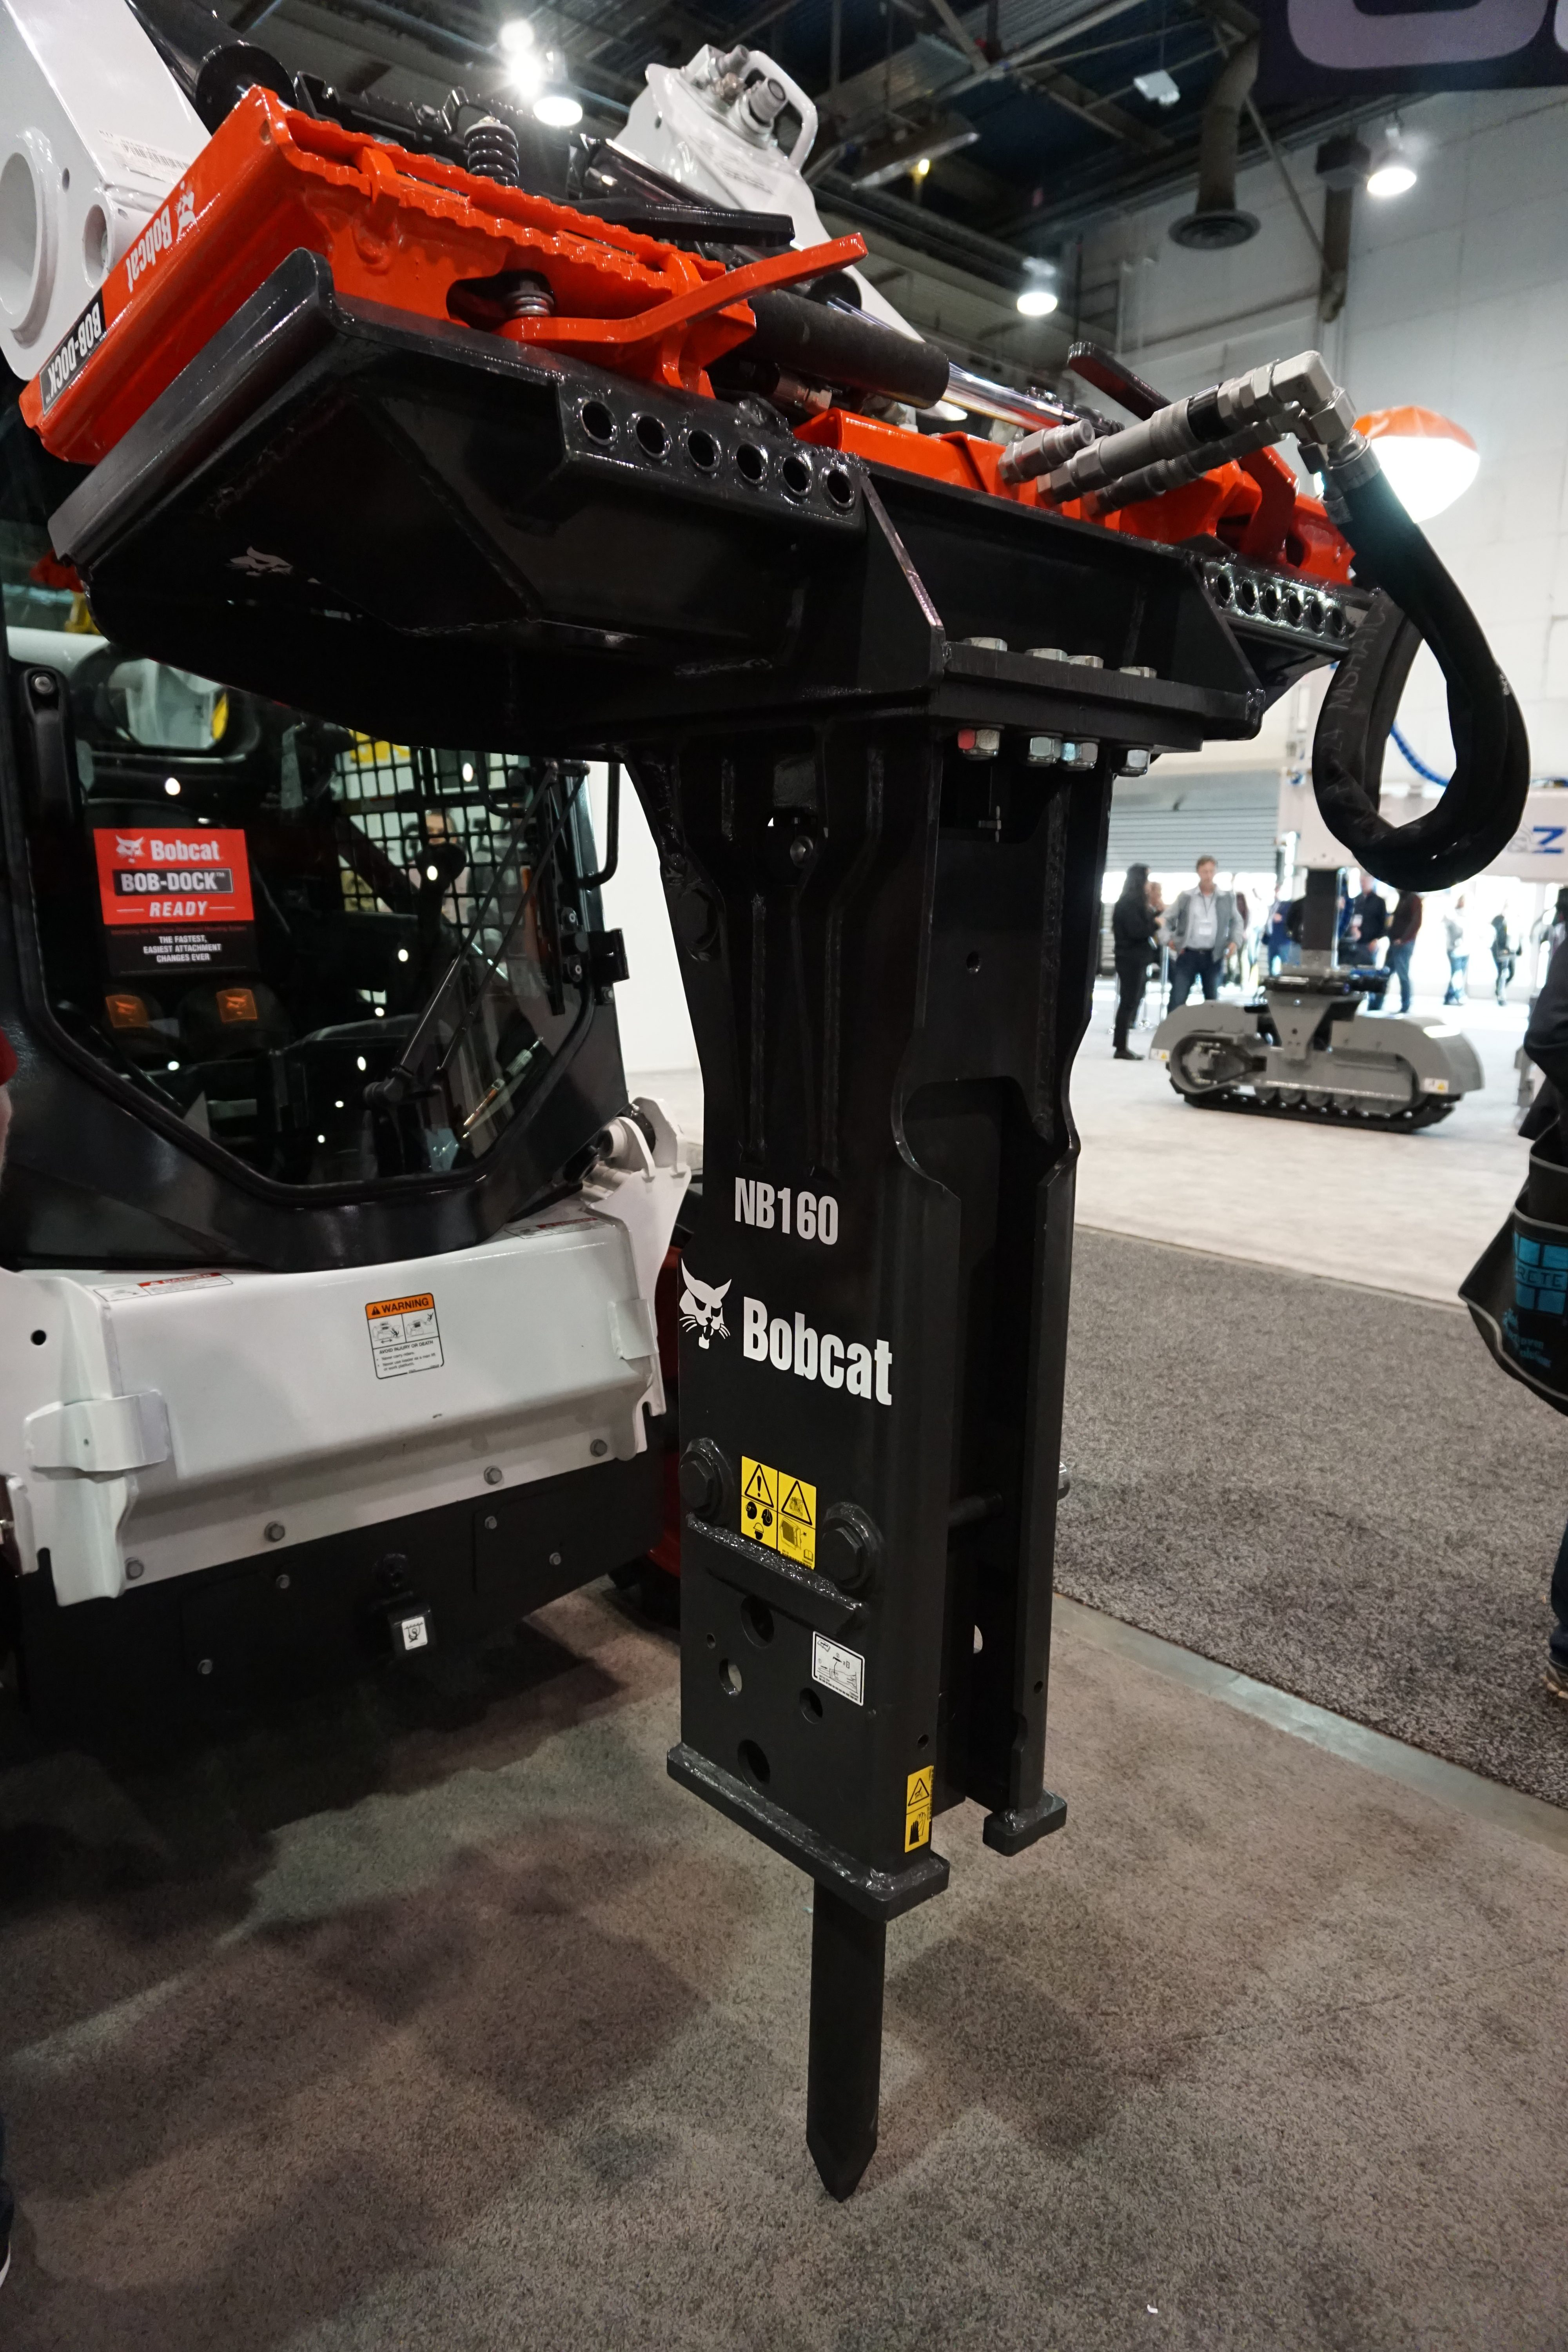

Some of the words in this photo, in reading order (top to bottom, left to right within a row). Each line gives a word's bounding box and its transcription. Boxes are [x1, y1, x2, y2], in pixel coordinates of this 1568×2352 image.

[126, 205, 172, 293] Bobcat
[151, 840, 220, 861] Bobcat
[149, 901, 208, 917] READY
[174, 935, 207, 943] FASTEST,
[143, 946, 172, 955] EASIEST
[175, 944, 222, 953] ATTACHMENT
[156, 954, 190, 963] CHANGES
[191, 953, 211, 961] EVER
[735, 1177, 838, 1245] NB160
[381, 1298, 429, 1313] WARNING
[743, 1296, 893, 1406] Bobcat
